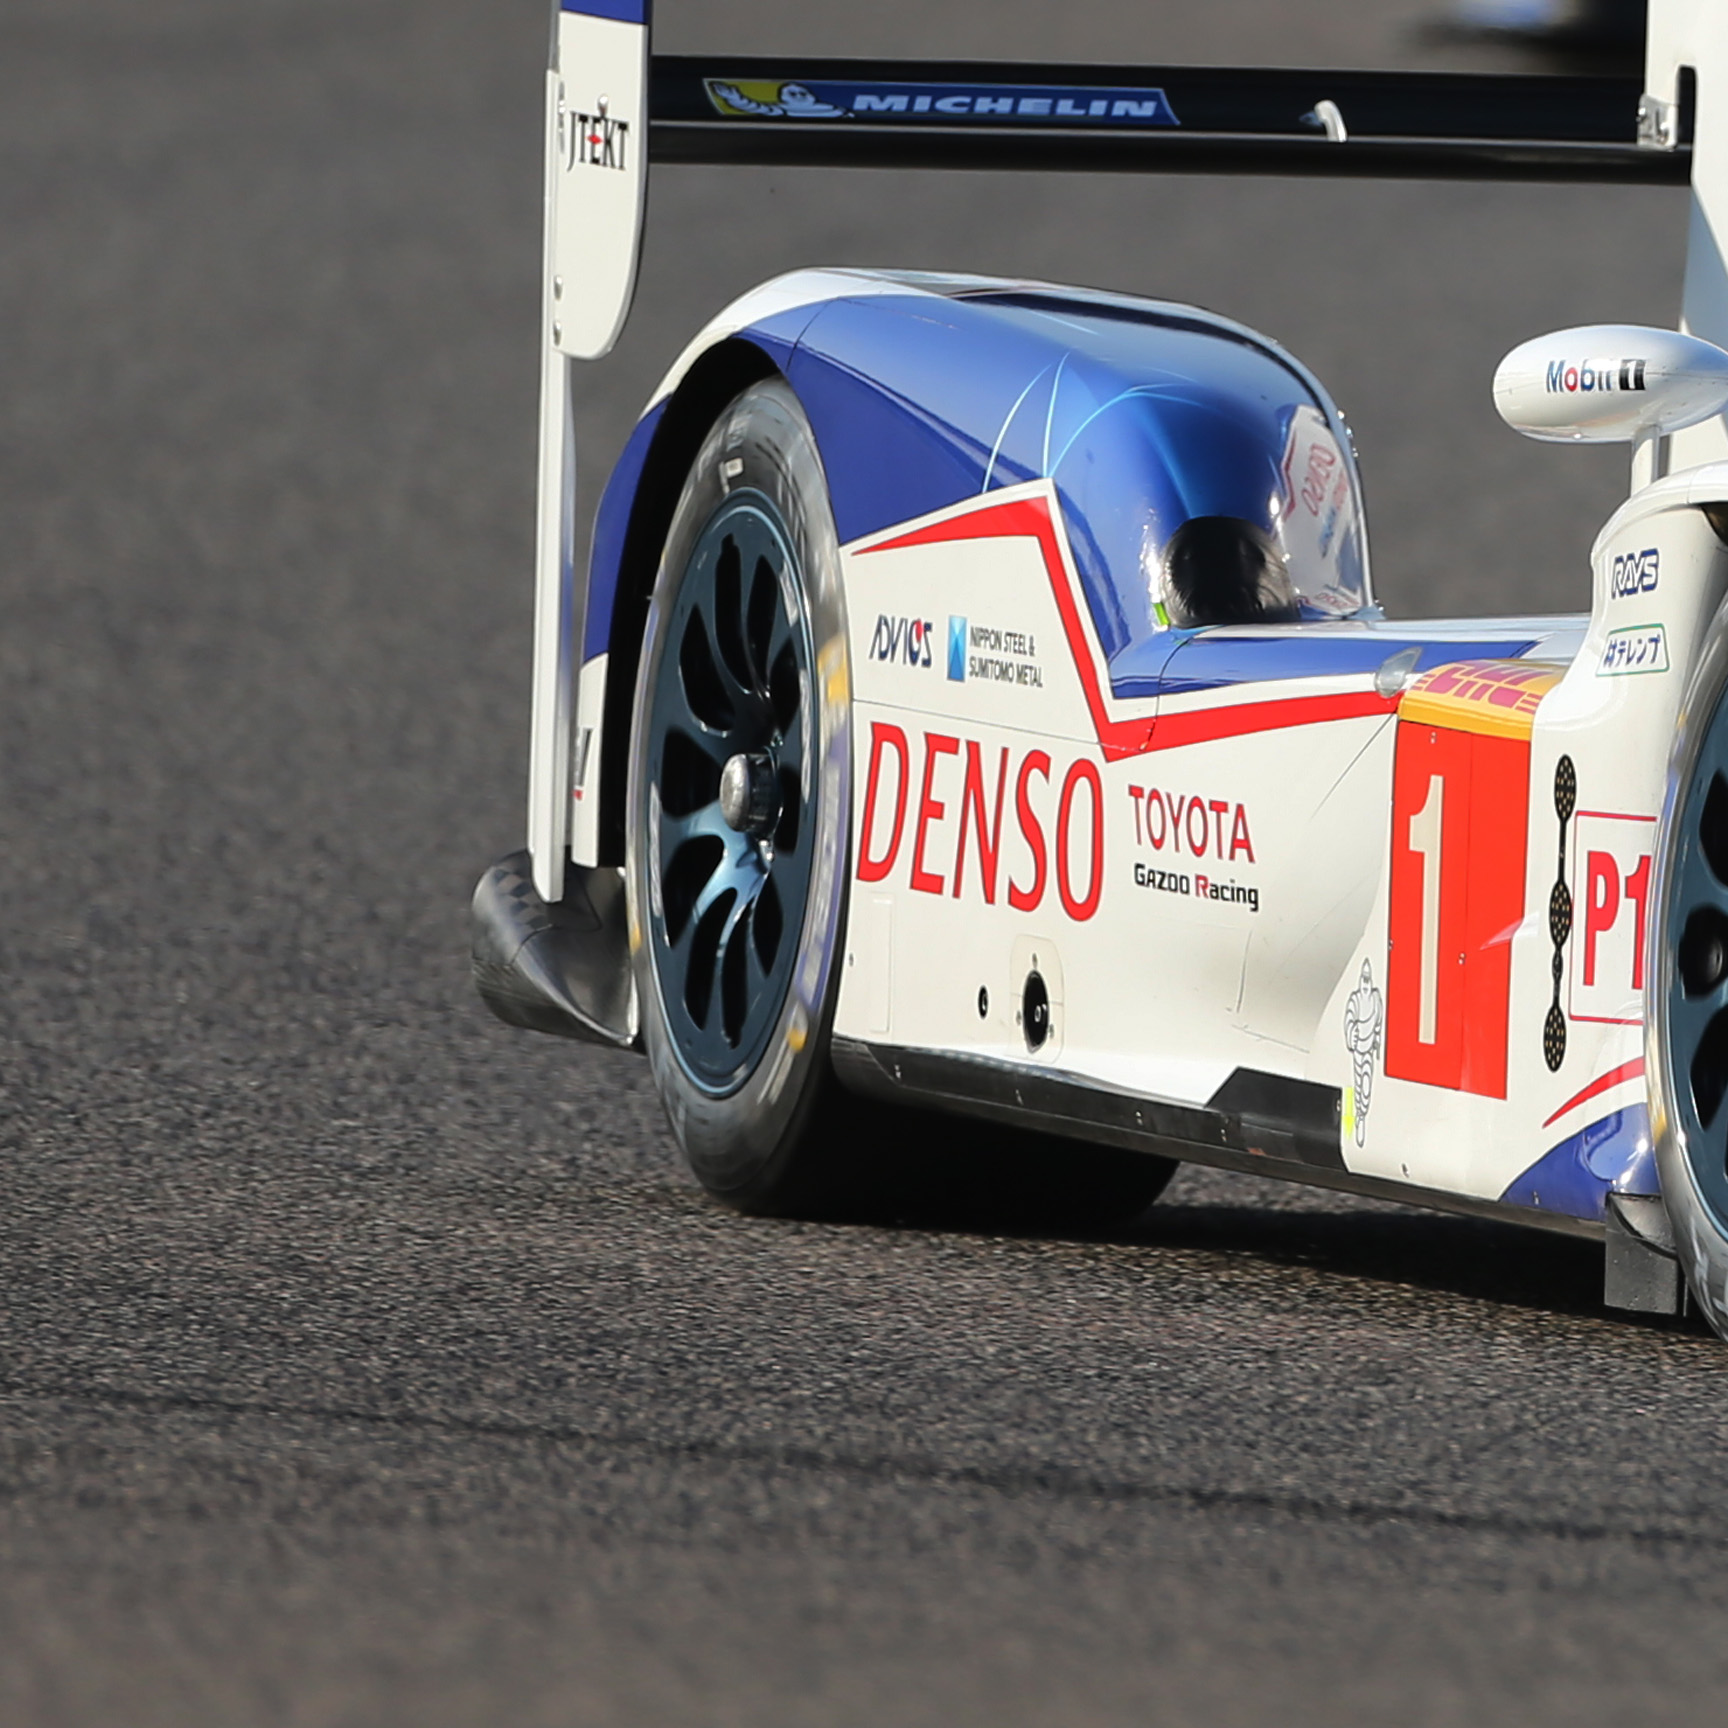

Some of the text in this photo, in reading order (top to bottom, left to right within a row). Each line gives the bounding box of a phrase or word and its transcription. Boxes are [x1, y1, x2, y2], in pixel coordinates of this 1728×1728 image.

[851, 93, 1159, 118] MICHELIN
[567, 109, 630, 173] JTEKT
[1611, 547, 1659, 600] RAYS
[868, 613, 934, 669] ADVICS
[970, 626, 1036, 658] NIPPON STEEL &
[969, 655, 1043, 688] SUMITOMO METAL
[856, 720, 1105, 922] DENSO
[1128, 783, 1256, 864] TOYOTA
[1194, 874, 1259, 912] Racing
[1408, 774, 1444, 1045] 1
[1582, 849, 1652, 991] P1
